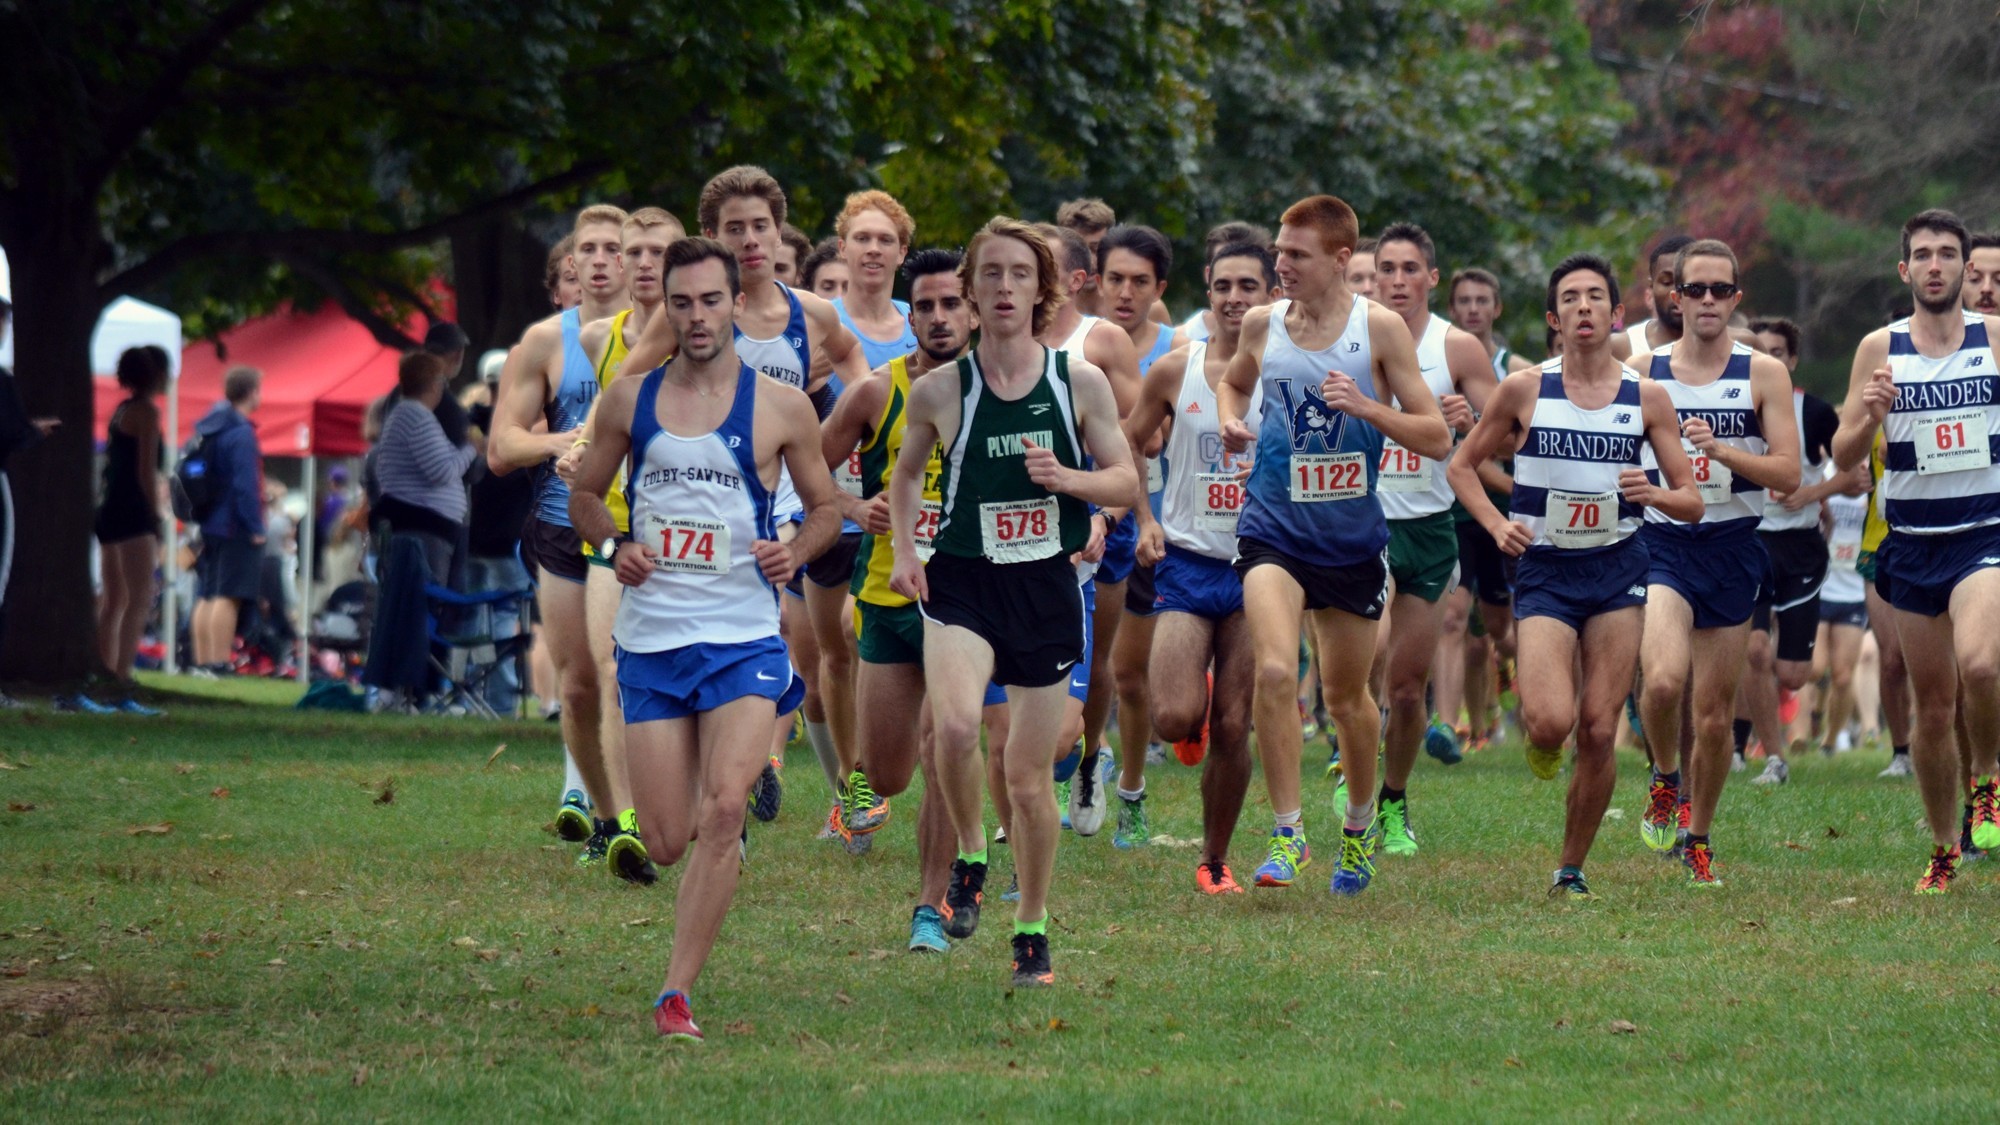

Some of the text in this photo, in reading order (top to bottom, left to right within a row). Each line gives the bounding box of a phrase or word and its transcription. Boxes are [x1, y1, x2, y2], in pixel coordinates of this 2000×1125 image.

[761, 366, 801, 386] SAWYER
[1894, 378, 1992, 411] BRANDEIS
[1934, 415, 1957, 423] JAMES
[1537, 431, 1635, 461] BRANDEIS
[1935, 422, 1965, 451] 61
[1378, 449, 1421, 472] 715
[1937, 449, 1981, 458] INVITATIONAL
[643, 467, 741, 491] COLBY-SAWYER
[1297, 463, 1362, 491] 1122
[1029, 500, 1055, 508] EARLEY
[1592, 494, 1614, 502] EARLEY
[669, 519, 696, 528] JAMES
[914, 509, 940, 539] 25
[996, 509, 1048, 541] 578
[1567, 503, 1599, 528] 70
[660, 528, 715, 562] 174
[1006, 537, 1049, 548] INVITATIONAL
[664, 561, 717, 571] INVITATIONAL
